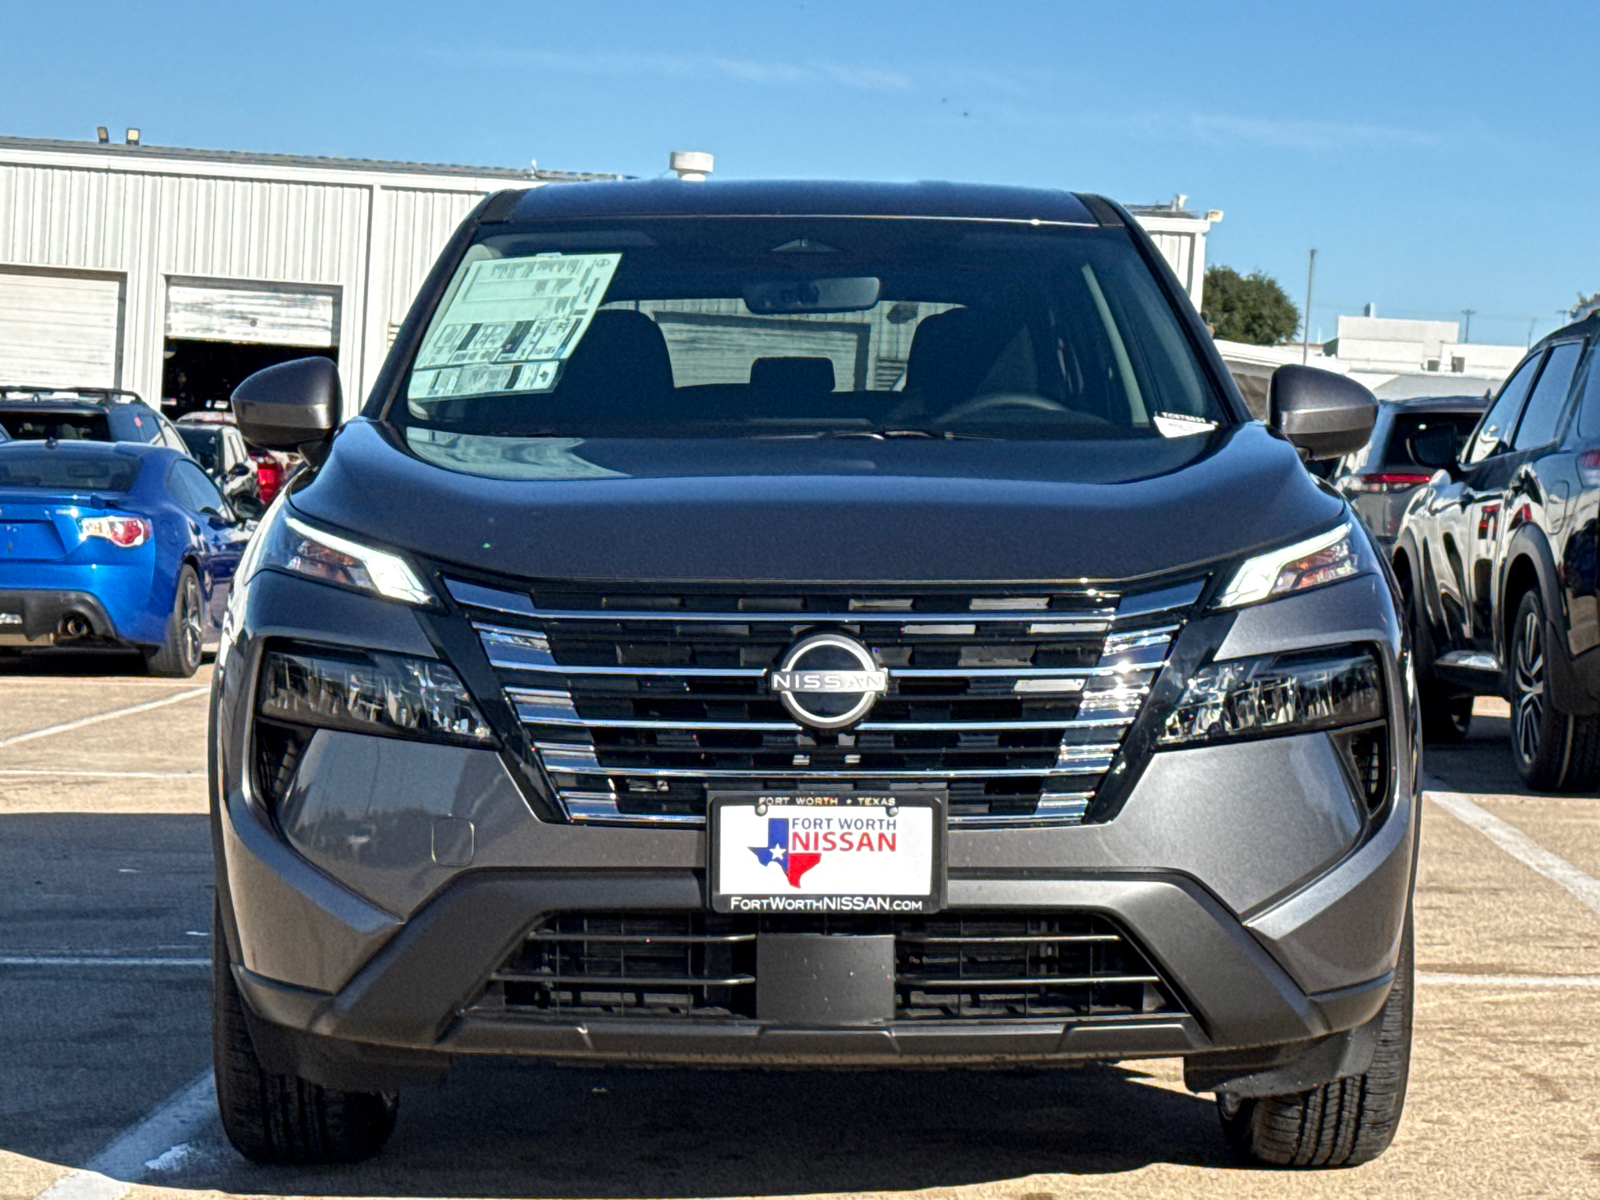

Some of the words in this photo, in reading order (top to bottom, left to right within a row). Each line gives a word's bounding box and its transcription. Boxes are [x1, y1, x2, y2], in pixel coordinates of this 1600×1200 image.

[773, 674, 882, 689] NISSAN
[758, 797, 790, 806] FORT
[795, 797, 839, 806] WORTH
[857, 797, 896, 806] TEXAS
[792, 818, 834, 830] FORT
[839, 818, 897, 830] WORTH
[792, 831, 897, 852] NISSAN
